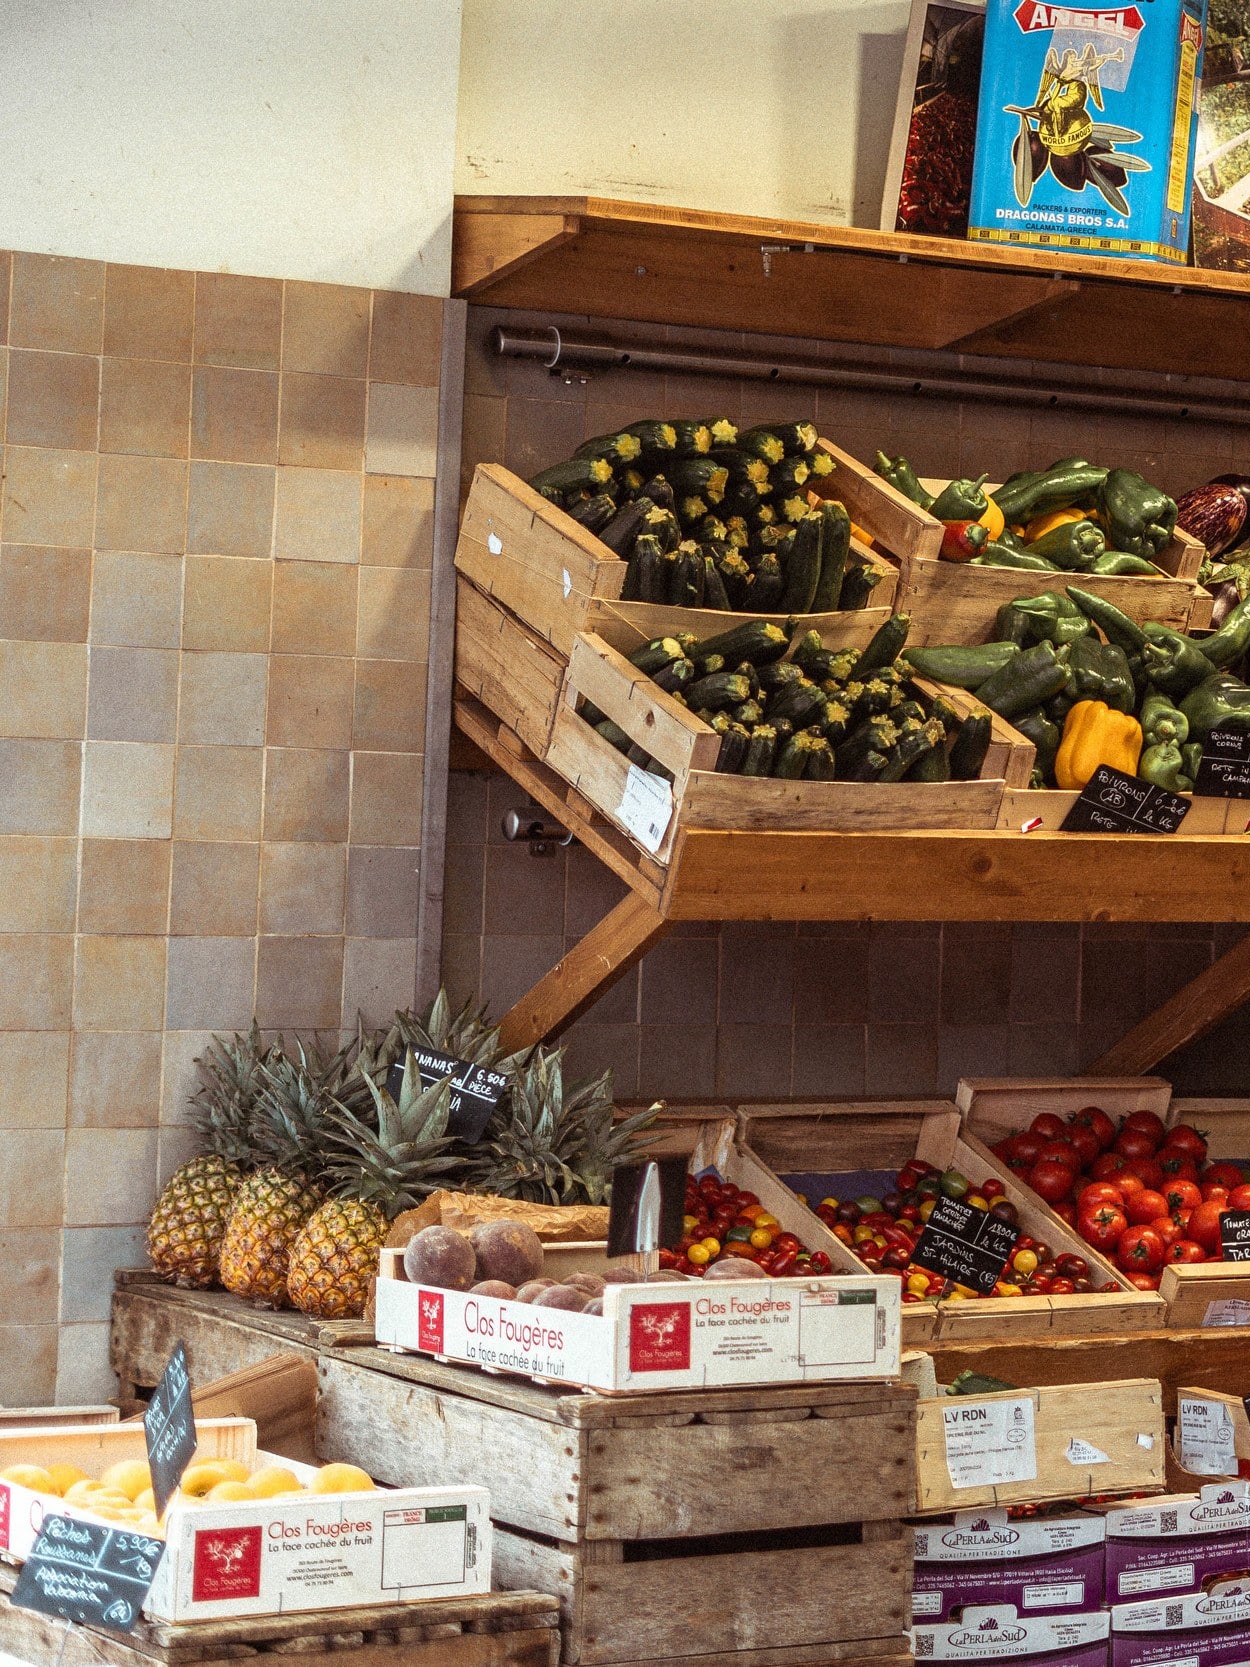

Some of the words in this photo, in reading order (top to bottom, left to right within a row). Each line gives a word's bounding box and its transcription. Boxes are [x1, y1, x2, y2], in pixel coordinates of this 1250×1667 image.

[1029, 4, 1130, 35] ANGEL
[1042, 136, 1065, 144] WORLD
[1068, 126, 1091, 142] FAMOUS
[1033, 204, 1063, 212] PACKERS
[1070, 207, 1107, 215] EXPORTERS
[996, 209, 1064, 223] DRAGONAS
[1068, 214, 1102, 226] BROS
[1105, 218, 1128, 229] S.A.
[696, 1298, 726, 1315] Clos
[731, 1297, 791, 1316] Fougères
[464, 1301, 494, 1337] Clos
[500, 1307, 564, 1351] Fougères
[696, 1318, 706, 1327] La
[708, 1318, 726, 1327] face
[728, 1316, 757, 1326] cachée
[760, 1316, 771, 1324] du
[773, 1314, 789, 1323] fruit
[466, 1341, 476, 1358] La
[478, 1344, 497, 1363] face
[499, 1349, 530, 1370] cachée
[532, 1357, 544, 1373] du
[547, 1357, 565, 1376] fruit
[639, 1350, 653, 1358] Clos
[945, 1412, 958, 1423] LV
[962, 1409, 987, 1421] RDN
[1183, 1404, 1191, 1414] LV
[1193, 1406, 1207, 1415] RDN
[268, 1521, 300, 1539] Clos
[306, 1518, 372, 1538] Fougères
[268, 1543, 279, 1552] La
[282, 1542, 302, 1552] face
[304, 1539, 337, 1550] cachée
[339, 1537, 352, 1547] du
[354, 1536, 372, 1545] fruit
[203, 1578, 218, 1587] Clos
